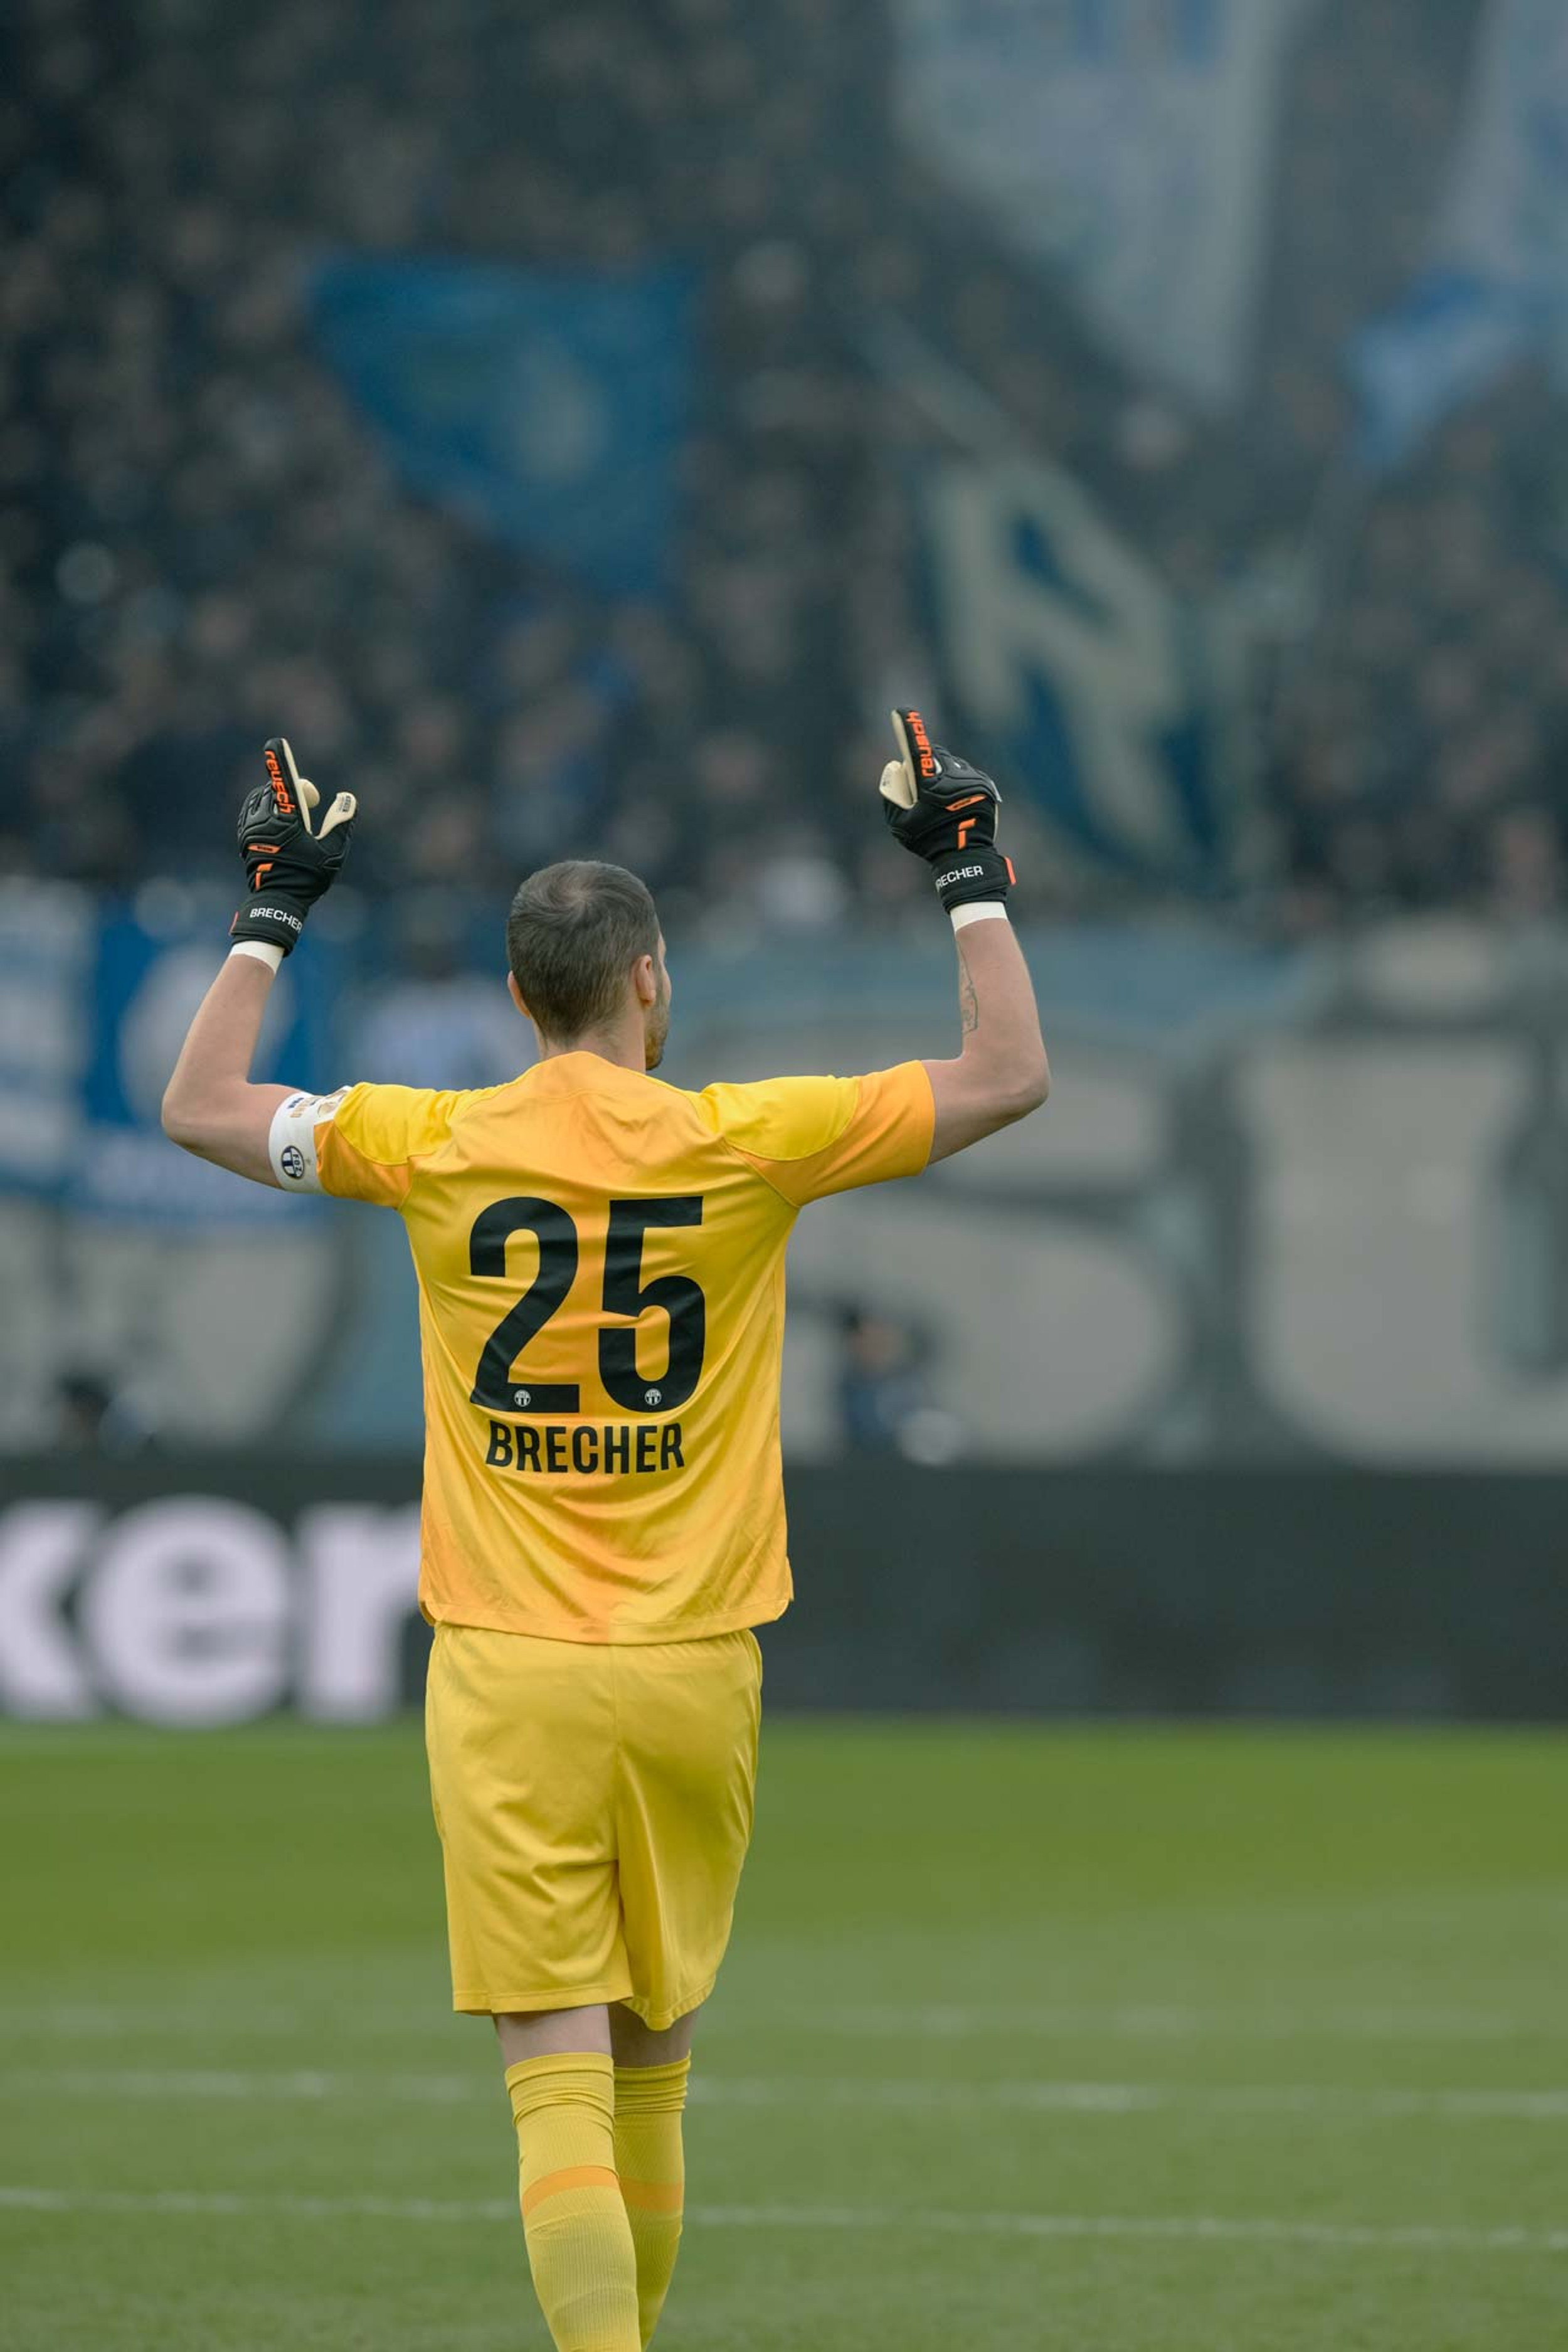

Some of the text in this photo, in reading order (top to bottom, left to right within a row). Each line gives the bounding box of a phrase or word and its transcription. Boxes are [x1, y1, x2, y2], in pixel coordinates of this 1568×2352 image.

[906, 711, 935, 777] reusch
[265, 750, 295, 814] reusch
[250, 908, 302, 933] BRECHER
[469, 1195, 706, 1413] 25
[486, 1419, 684, 1474] BRECHER
